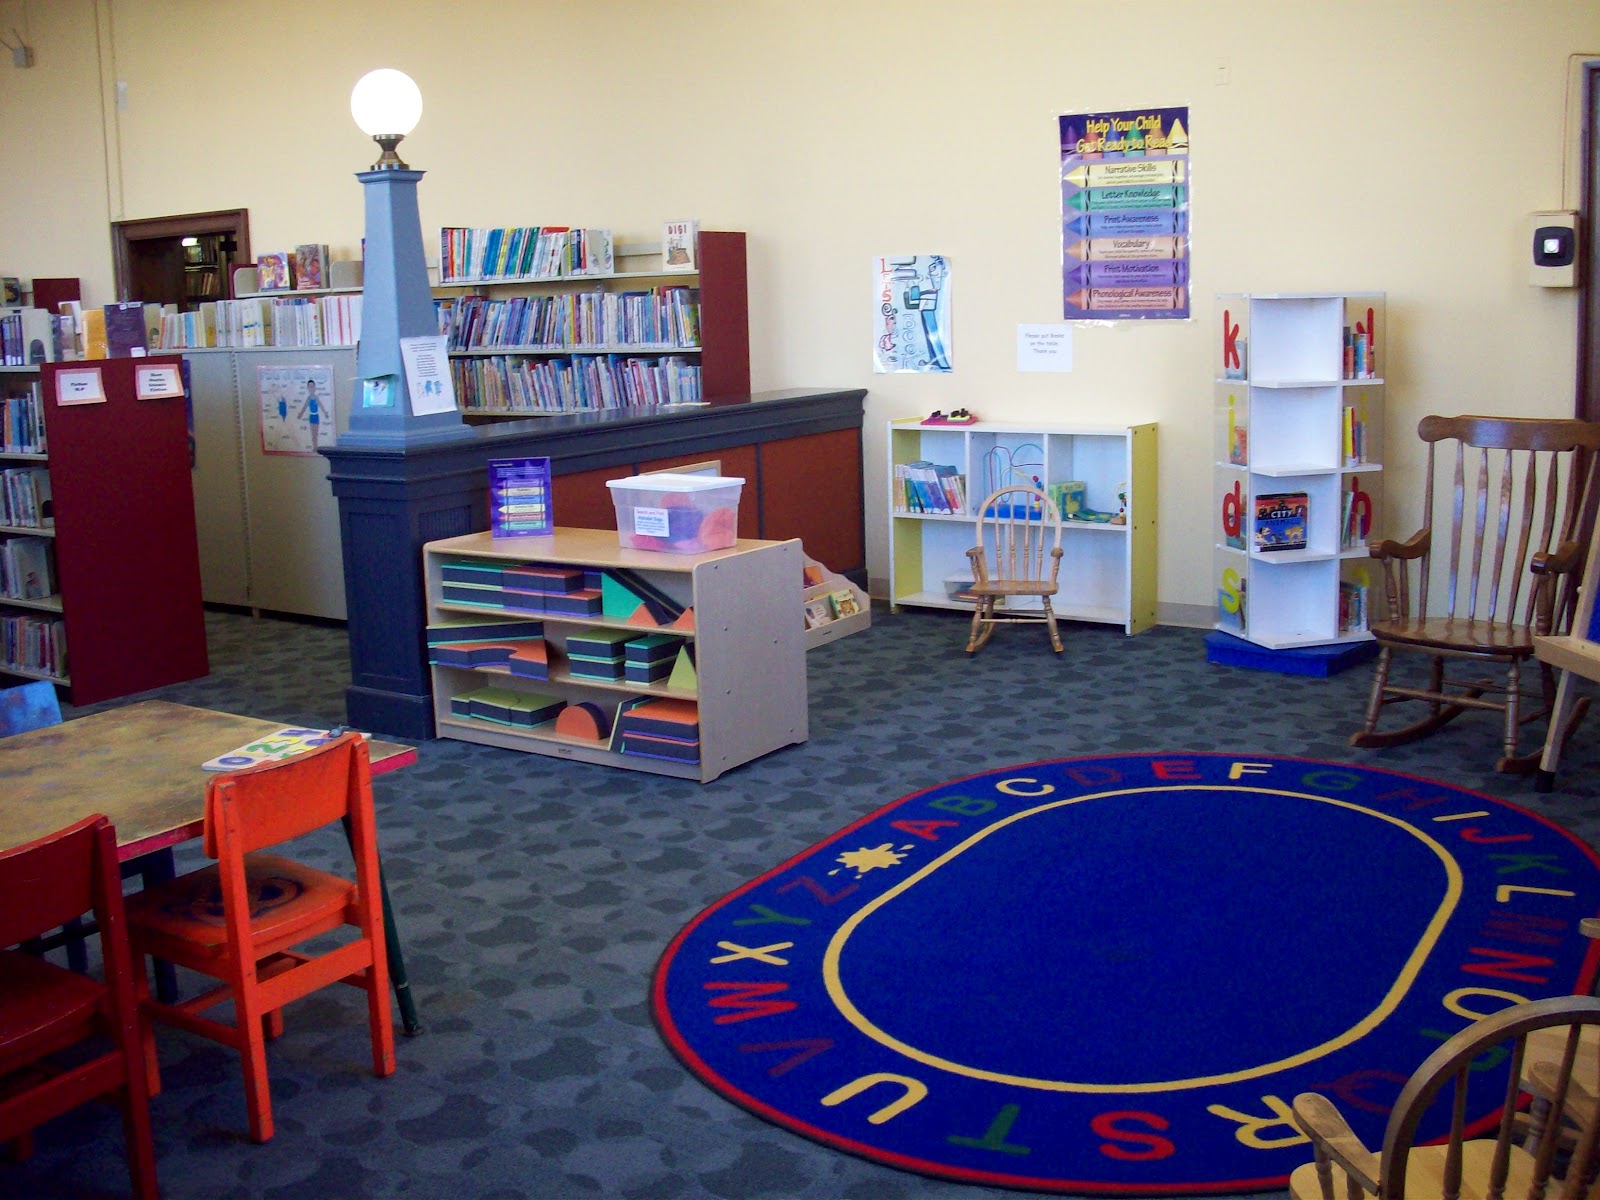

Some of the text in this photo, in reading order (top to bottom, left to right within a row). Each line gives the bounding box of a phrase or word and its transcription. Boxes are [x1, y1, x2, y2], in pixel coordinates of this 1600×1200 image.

[1086, 114, 1162, 138] Help Your Child
[1076, 134, 1173, 153] Get Ready to Read
[1104, 163, 1157, 174] Narrative Skills
[1101, 188, 1161, 200] Letter Knowledge
[1103, 214, 1160, 224] Print Awareness
[1112, 239, 1150, 249] Vocabulary
[1104, 263, 1160, 273] Print Motivation
[1092, 288, 1172, 300] Phonological Awareness
[1270, 510, 1293, 519] CITY
[246, 743, 290, 753] 2
[1065, 766, 1122, 787] D
[1151, 760, 1202, 780] E
[1228, 762, 1273, 780] F
[995, 777, 1056, 797] C
[1302, 770, 1363, 792] G
[928, 795, 998, 816] B
[1376, 787, 1448, 811] H
[1432, 810, 1491, 823] I
[889, 819, 960, 841] A
[1459, 828, 1534, 844] J
[1488, 853, 1568, 874] K
[776, 875, 860, 906] Z
[1495, 884, 1576, 903] L
[732, 904, 812, 926] Y
[1480, 910, 1568, 945] M
[710, 941, 794, 966] X
[1459, 947, 1555, 984] N
[702, 981, 798, 1025] W
[1442, 987, 1537, 1022] O
[738, 1038, 835, 1076] V
[820, 1072, 929, 1125] U
[946, 1103, 1031, 1155] T
[1206, 1095, 1313, 1150] R
[1090, 1110, 1175, 1161] S
